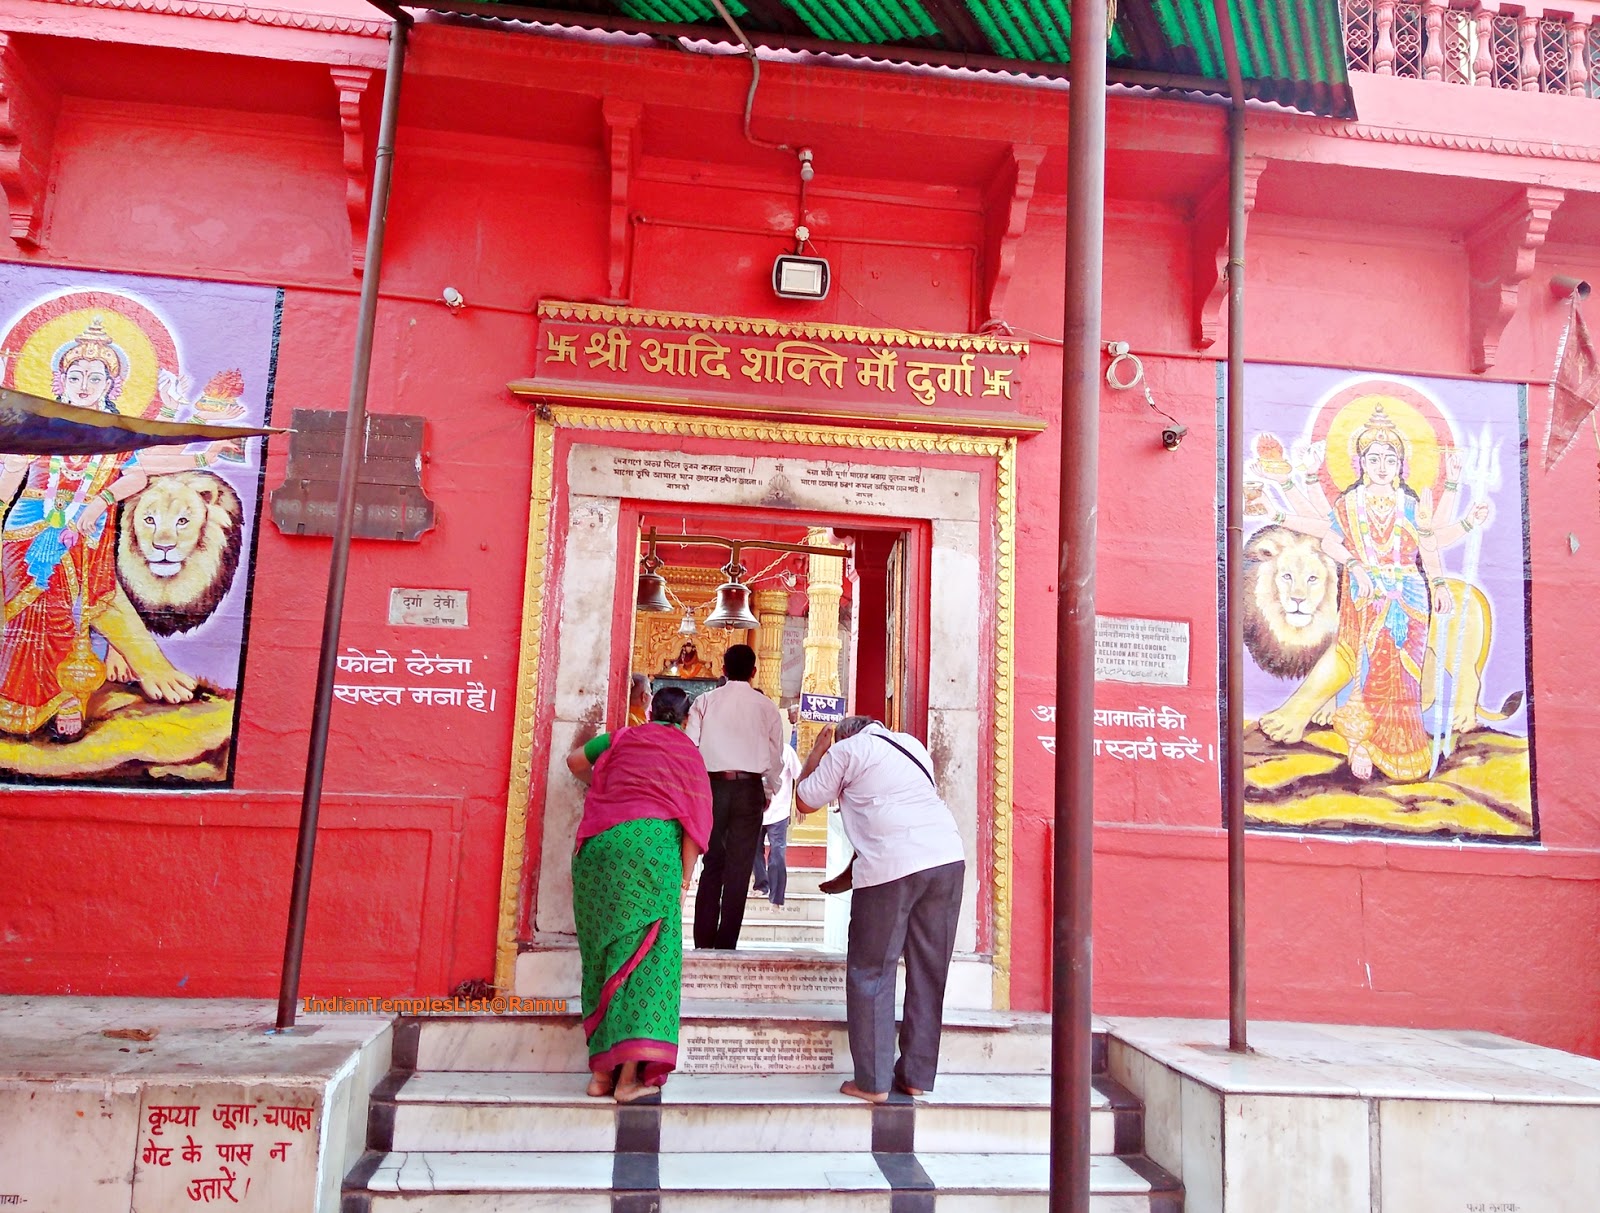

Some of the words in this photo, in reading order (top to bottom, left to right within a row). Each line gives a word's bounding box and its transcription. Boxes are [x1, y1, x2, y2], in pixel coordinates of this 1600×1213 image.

[584, 328, 631, 371] श्री
[639, 333, 731, 380] आदि
[740, 340, 848, 390] शक्ति
[856, 347, 897, 392] माँ
[904, 353, 979, 406] दुर्गा
[306, 501, 363, 518] SHOS
[368, 503, 427, 522] INSDE
[1095, 640, 1118, 649] TLEMEN
[336, 647, 398, 674] फोटो
[407, 686, 465, 706] मना
[1104, 736, 1158, 761] स्वयं
[142, 1138, 174, 1167] गेट
[180, 1135, 202, 1164] के
[215, 1142, 254, 1166] पास
[269, 1141, 293, 1163] न
